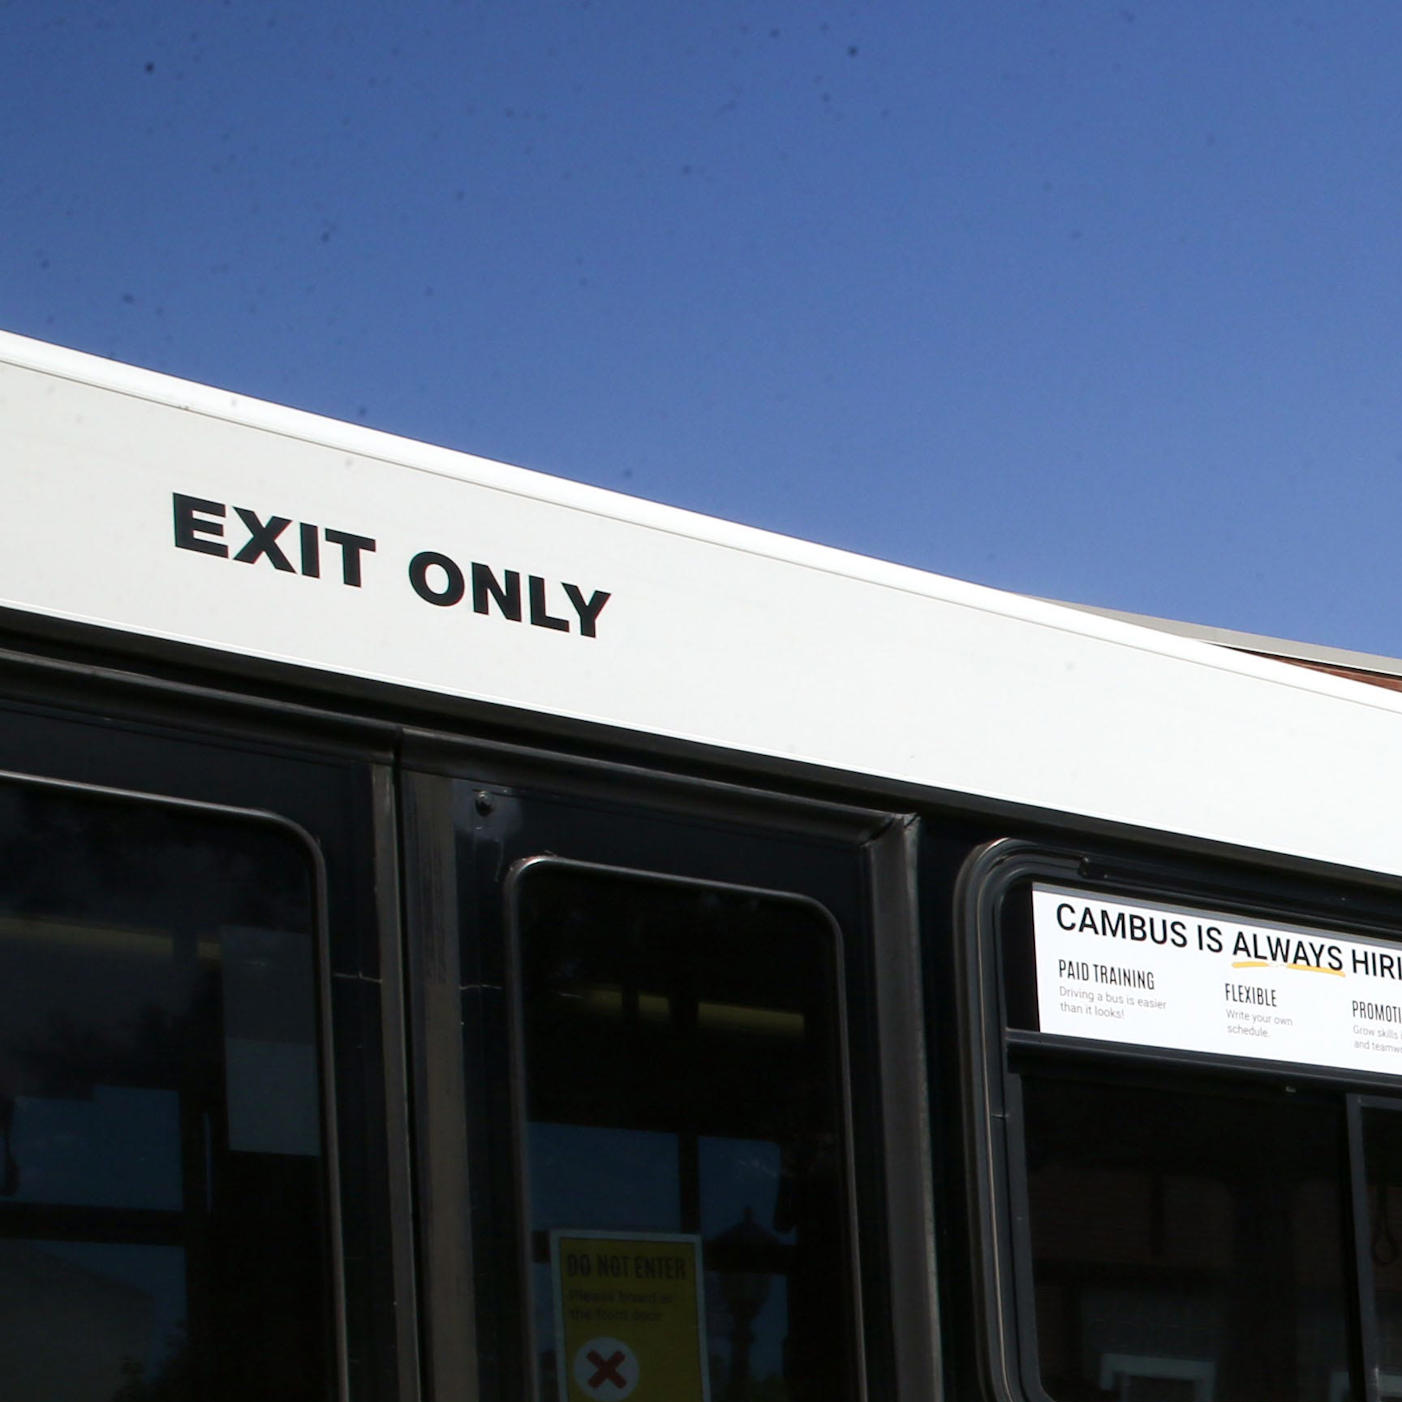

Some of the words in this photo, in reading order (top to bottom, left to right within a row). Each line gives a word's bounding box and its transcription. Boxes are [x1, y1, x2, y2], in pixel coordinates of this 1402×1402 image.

[172, 491, 377, 589] EXIT
[408, 551, 612, 639] ONLY
[1056, 902, 1188, 948] CAMBUS
[1197, 924, 1224, 953] IS
[1232, 931, 1344, 971] ALWAYS
[1058, 958, 1089, 981] PAID
[1093, 963, 1155, 990] TRAINING
[1059, 986, 1095, 1003] Driving
[1097, 993, 1104, 1002] a
[1105, 991, 1124, 1005] bus
[1126, 995, 1135, 1006] is
[1137, 997, 1167, 1010] easier
[1225, 983, 1277, 1008] FLEXIBLE
[1060, 1002, 1083, 1014] than
[1085, 1005, 1092, 1015] it
[1094, 1006, 1125, 1019] looks!
[1226, 1009, 1251, 1022] Write
[1251, 1013, 1272, 1025] your
[1274, 1016, 1293, 1026] own
[1227, 1023, 1270, 1038] schedule.
[1353, 1024, 1375, 1037] Grow
[1377, 1026, 1398, 1040] skills
[1354, 1039, 1370, 1050] and
[567, 1253, 591, 1278] DO
[597, 1254, 629, 1278] NOT
[634, 1255, 687, 1280] ENTER
